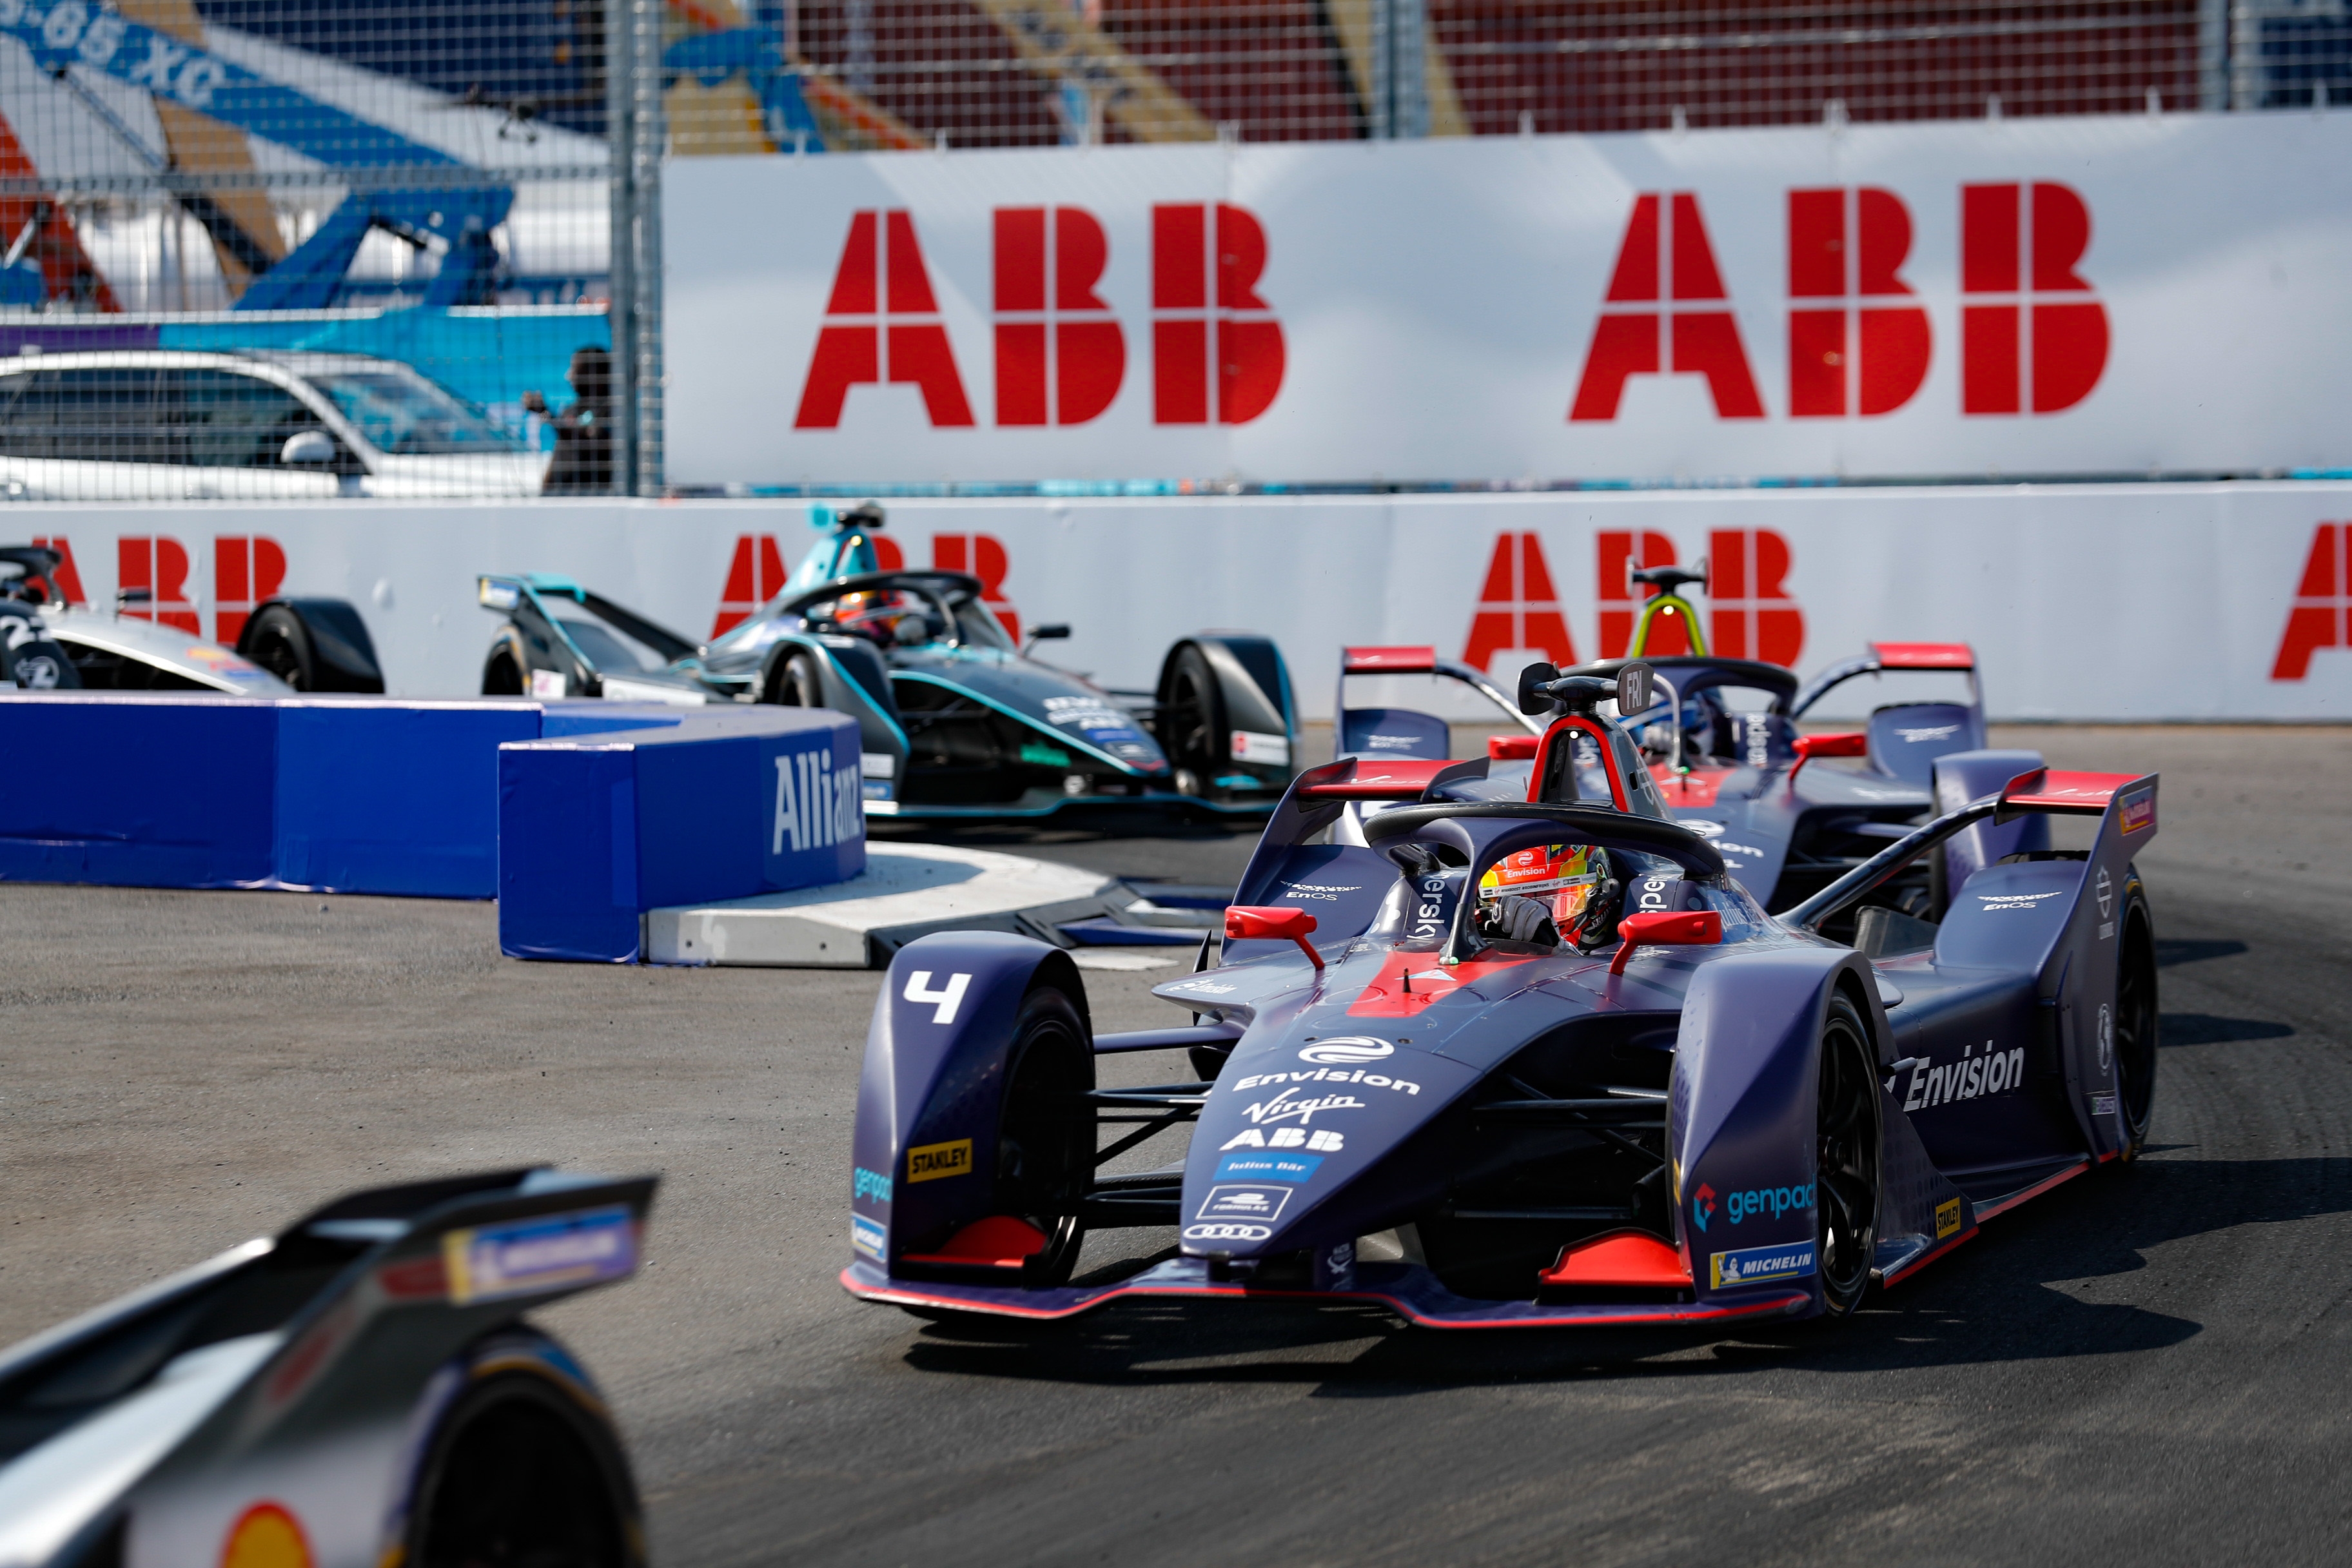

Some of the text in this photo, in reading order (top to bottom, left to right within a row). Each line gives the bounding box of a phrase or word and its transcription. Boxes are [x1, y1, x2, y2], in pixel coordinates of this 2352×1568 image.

[793, 200, 1288, 429] ABB
[1567, 179, 2112, 422] ABB
[1460, 526, 1805, 675] ABB
[1627, 670, 1642, 710] FRI
[772, 748, 861, 856] Allianz
[1507, 867, 1545, 879] Envision
[1982, 901, 2037, 912] EnOS
[903, 970, 973, 1024] 4
[1232, 1068, 1421, 1095] Envision
[1903, 1039, 2025, 1112] Envision
[1241, 1086, 1366, 1125] Virgin
[1218, 1127, 1345, 1152] ABB
[912, 1146, 968, 1174] STANLEY
[1228, 1161, 1273, 1171] Julius
[1937, 1205, 1959, 1232] STANLEY
[1742, 1252, 1812, 1275] MICHELIN
